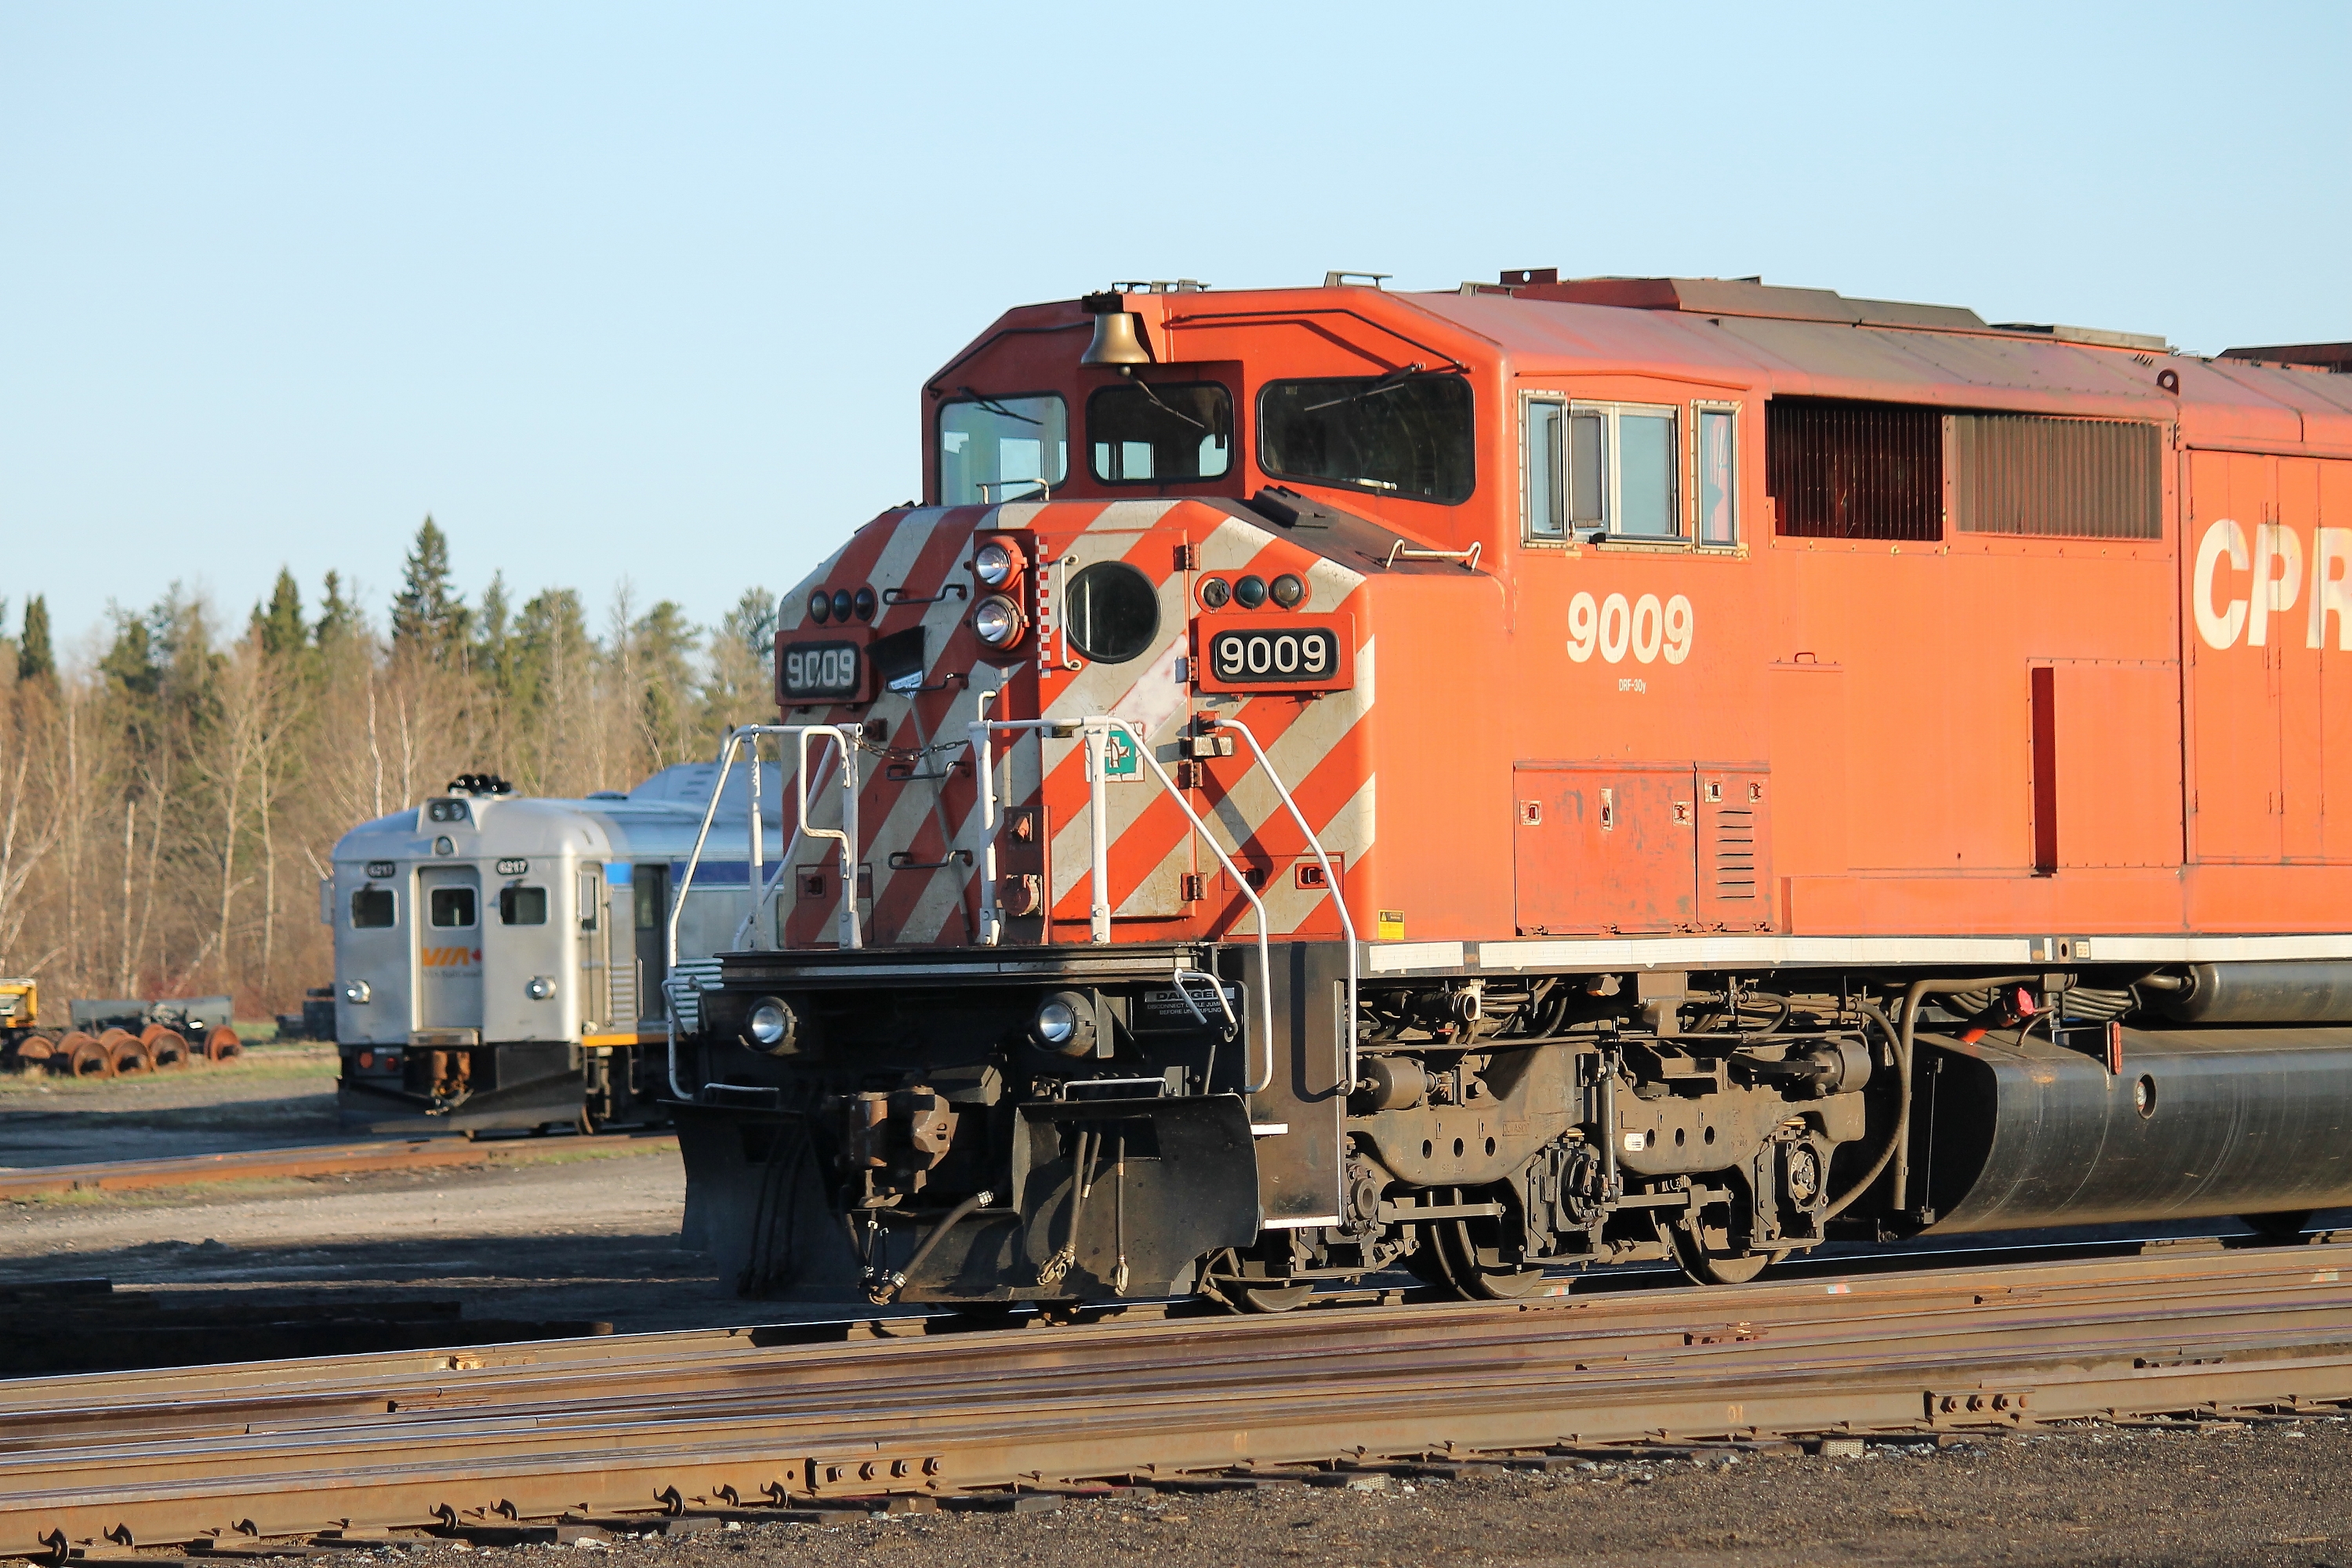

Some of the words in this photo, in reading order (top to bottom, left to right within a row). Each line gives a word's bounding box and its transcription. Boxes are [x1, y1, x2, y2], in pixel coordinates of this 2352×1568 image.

[1566, 591, 1693, 665] 9009
[787, 648, 855, 688] 9009
[1220, 633, 1327, 675] 9009
[1618, 678, 1646, 695] DRF-30y
[423, 946, 469, 966] VIA
